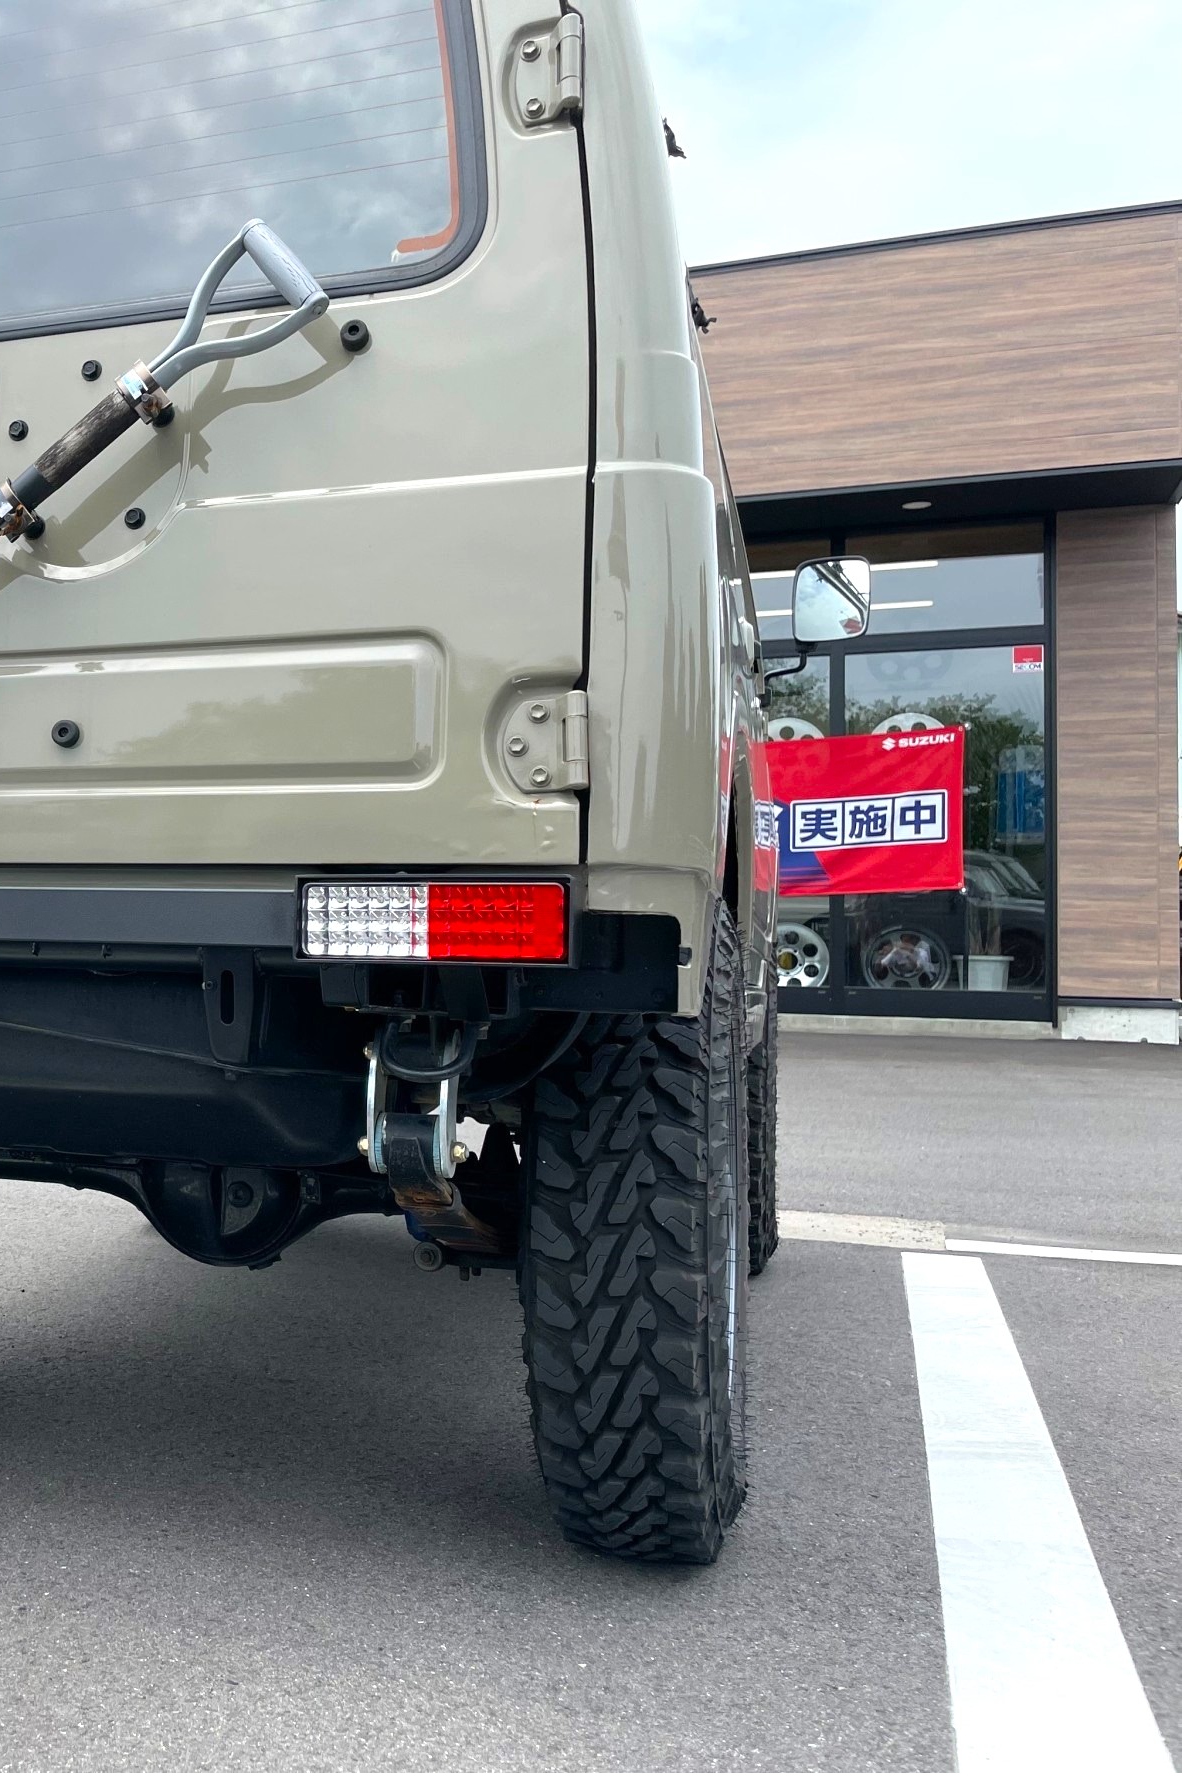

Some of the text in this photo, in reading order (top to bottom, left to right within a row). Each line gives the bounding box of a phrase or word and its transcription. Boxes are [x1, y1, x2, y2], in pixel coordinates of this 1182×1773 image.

[898, 733, 955, 748] SUZUKI
[799, 800, 937, 843] 実施中
